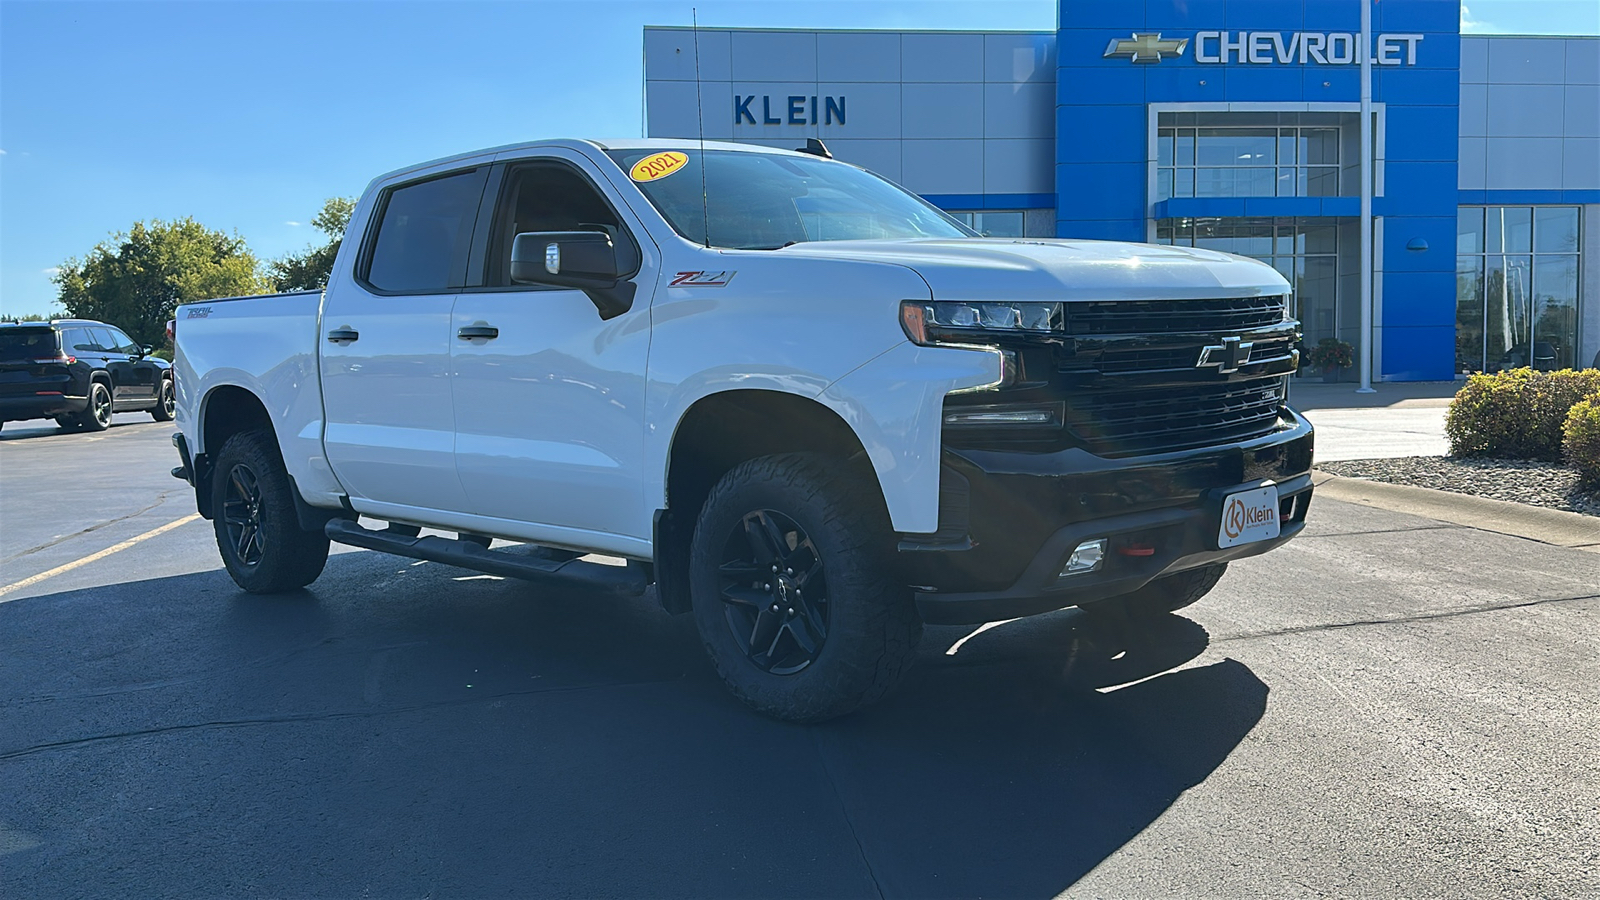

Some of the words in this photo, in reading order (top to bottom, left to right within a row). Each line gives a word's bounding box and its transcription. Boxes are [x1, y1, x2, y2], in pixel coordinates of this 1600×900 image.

[1196, 31, 1424, 65] CHEVROLET
[735, 95, 846, 125] KLEIN
[640, 153, 681, 178] 2021
[187, 306, 213, 314] TRAIL
[1246, 505, 1274, 524] Klein
